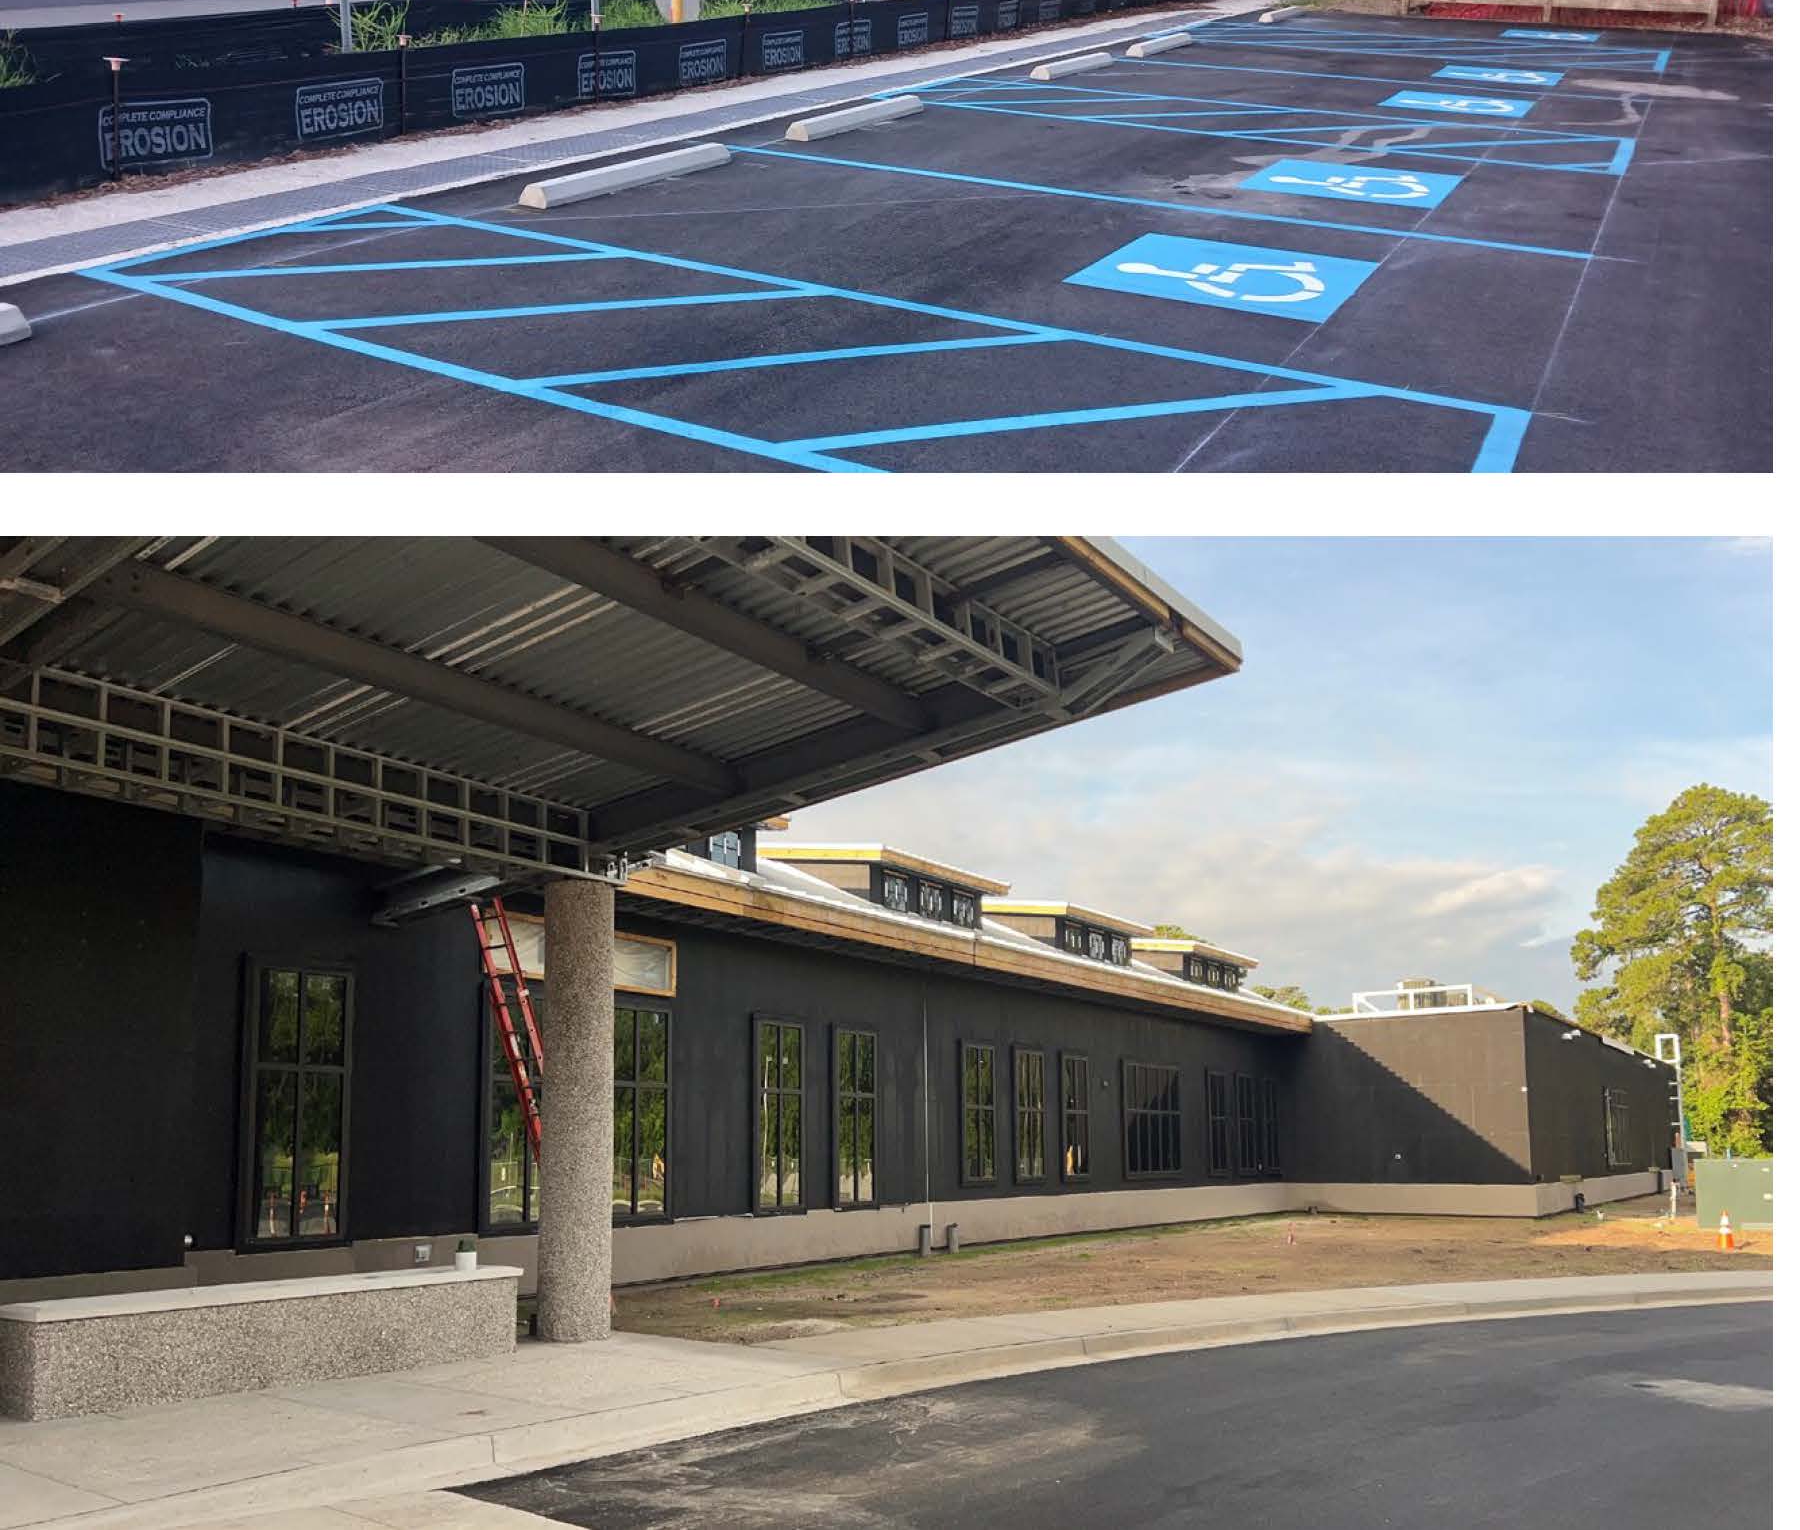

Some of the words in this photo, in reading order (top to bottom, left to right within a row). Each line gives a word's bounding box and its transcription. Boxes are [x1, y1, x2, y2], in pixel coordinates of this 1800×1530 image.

[764, 46, 801, 65] EROSION
[681, 55, 724, 79] EROSION
[299, 90, 337, 105] COMPLETE
[337, 85, 380, 100] COMPLIANCE
[455, 82, 521, 111] EROSION
[102, 110, 148, 126] COPLETE
[149, 107, 206, 121] COMPLIANCE
[300, 98, 380, 134] EROSION
